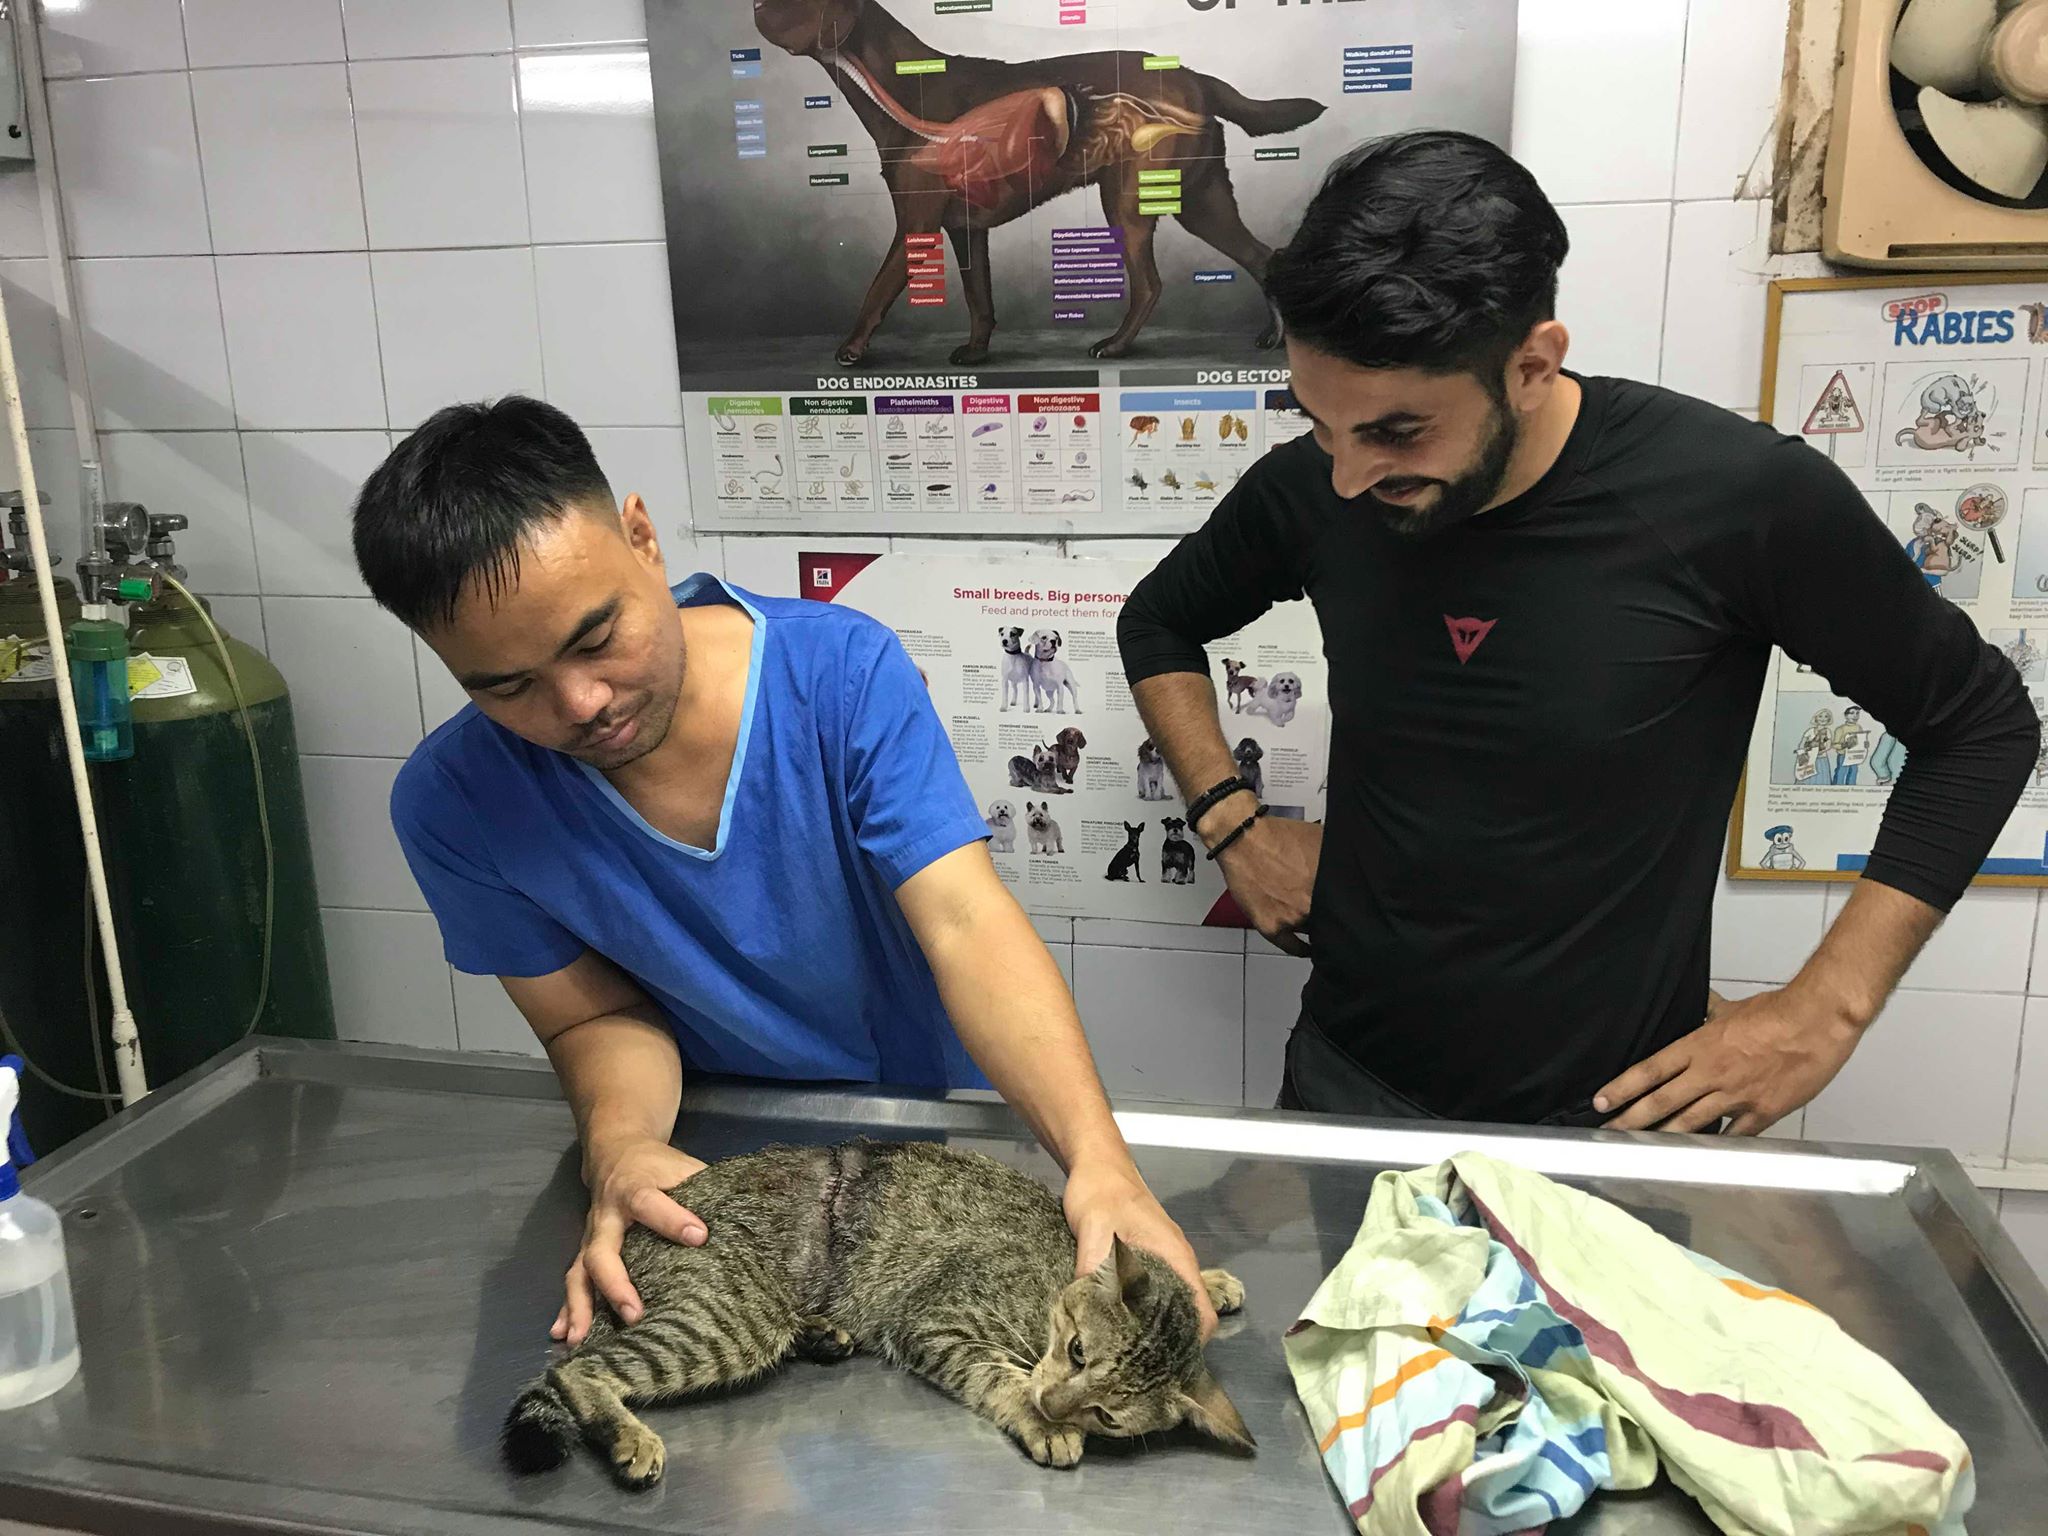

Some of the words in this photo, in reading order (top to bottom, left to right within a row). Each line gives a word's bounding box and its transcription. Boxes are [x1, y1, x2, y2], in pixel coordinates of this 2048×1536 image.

[1345, 51, 1369, 59] Walking
[1888, 297, 1942, 318] STOP
[1894, 309, 2015, 346] RABIES
[816, 376, 850, 390] DOG
[853, 375, 978, 389] ENDOPARASITES
[1196, 370, 1233, 384] DOG
[1237, 369, 1292, 383] ECTOP
[821, 399, 853, 407] digestive
[890, 398, 939, 406] Plathelminths
[969, 397, 1004, 405] Digestive
[1051, 396, 1085, 404] digestive
[1959, 536, 1984, 555] SLURP!
[1951, 544, 1976, 563] SLURP!
[953, 588, 990, 599] Small
[994, 588, 1044, 601] breeds.
[1047, 590, 1070, 604] Big
[1074, 592, 1130, 604] persona
[981, 605, 1007, 615] Feed
[1010, 606, 1029, 616] and
[1031, 607, 1069, 618] protect
[1072, 608, 1099, 618] them
[1102, 608, 1116, 618] for
